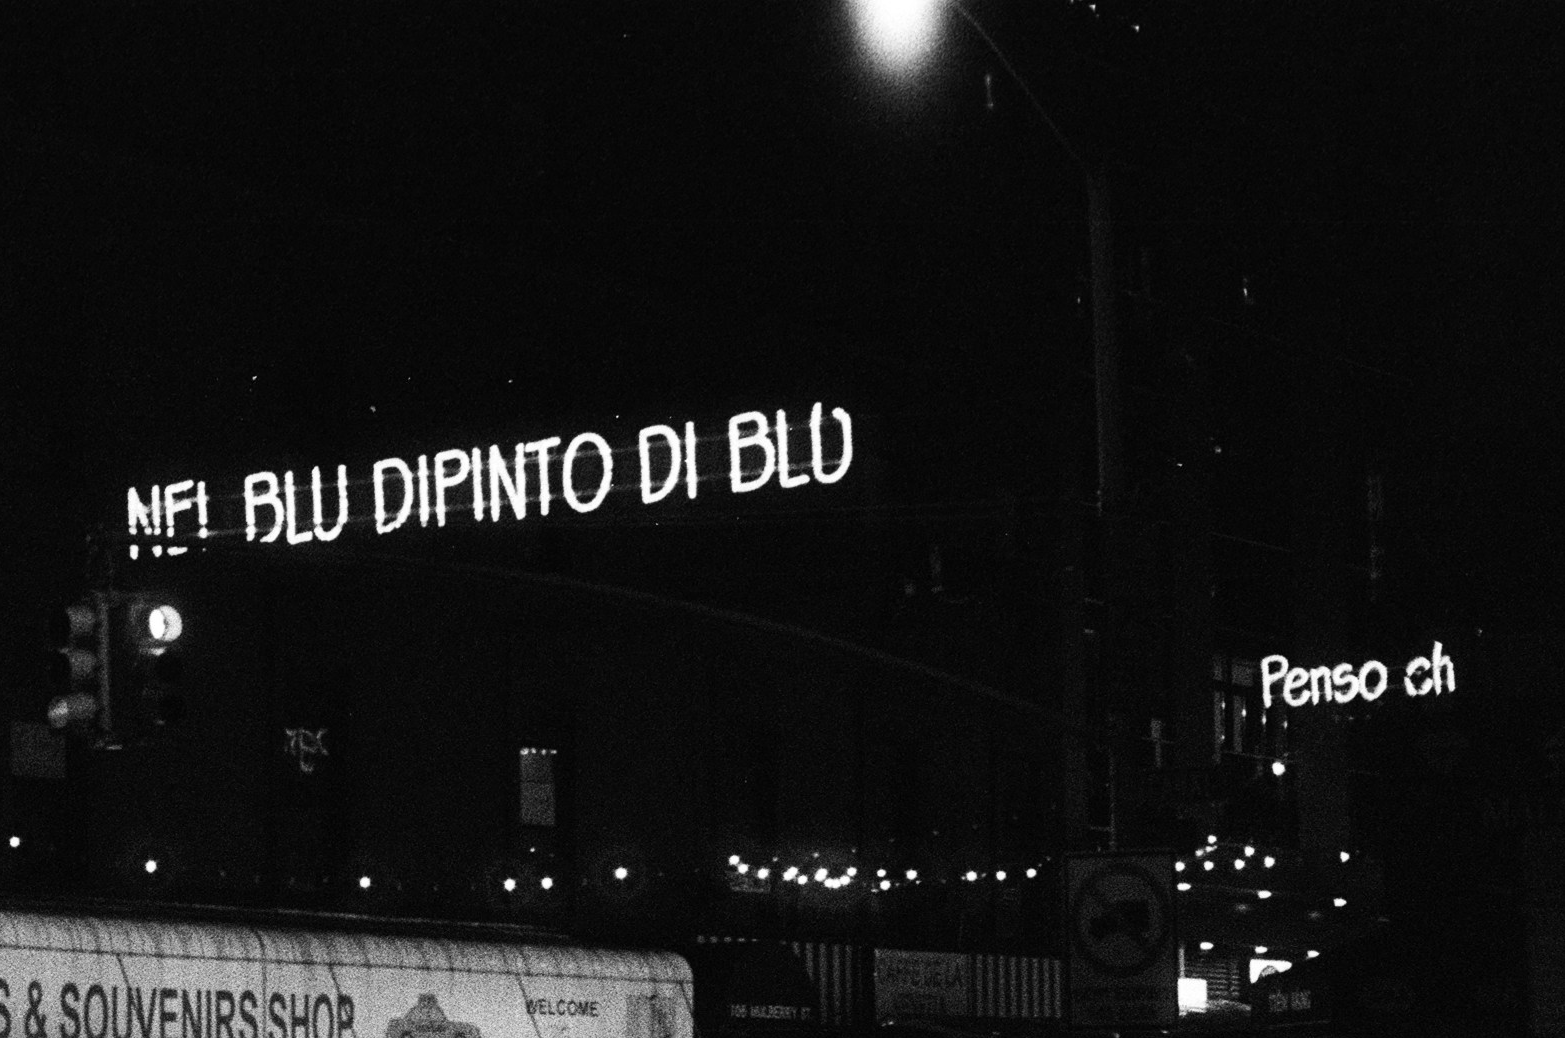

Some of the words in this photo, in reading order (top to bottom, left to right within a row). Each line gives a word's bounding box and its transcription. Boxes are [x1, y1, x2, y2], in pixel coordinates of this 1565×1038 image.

[244, 464, 348, 544] BLU
[373, 432, 613, 533] DIPINTO
[640, 421, 697, 504] DI
[730, 402, 853, 493] BLU
[1260, 654, 1388, 708] Penso
[1404, 640, 1456, 697] ch
[526, 998, 599, 1018] WELCOME
